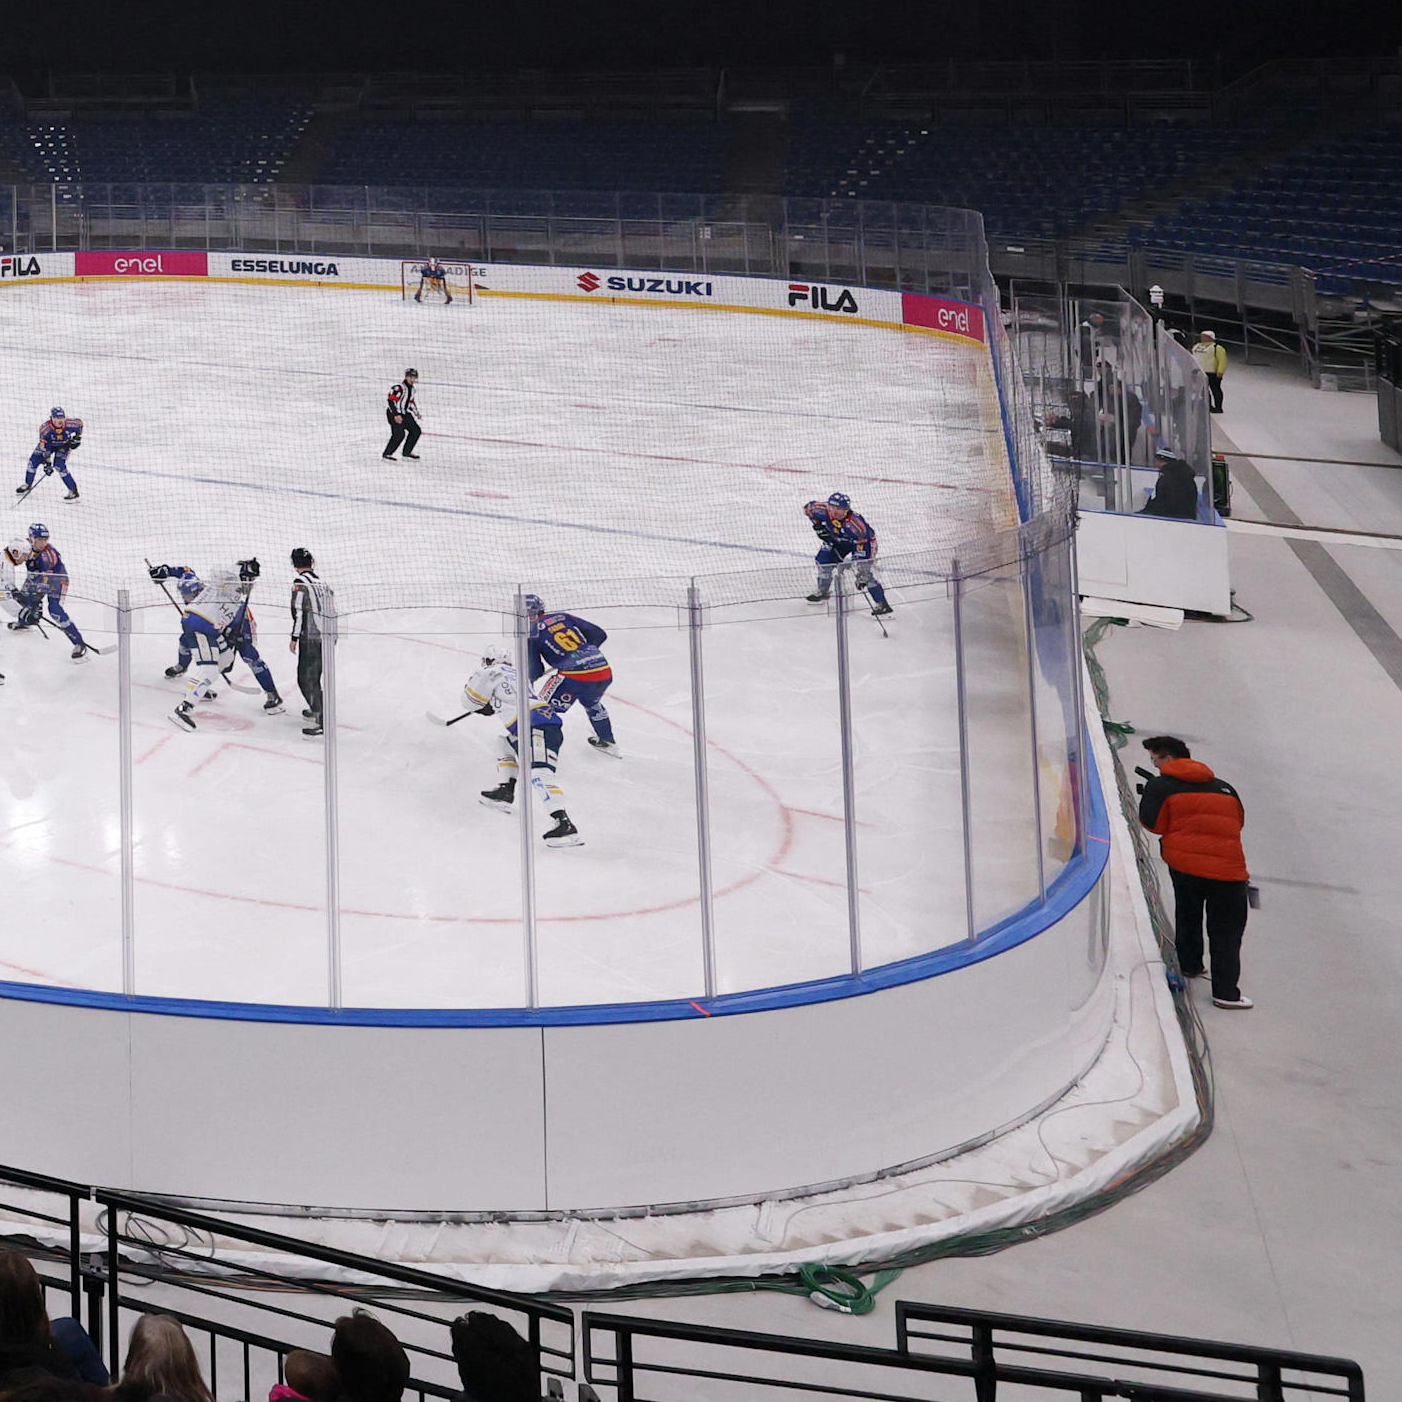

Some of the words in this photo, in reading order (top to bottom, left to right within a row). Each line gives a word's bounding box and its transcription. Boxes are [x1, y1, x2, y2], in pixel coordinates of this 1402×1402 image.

[1, 256, 40, 278] FILA
[114, 254, 163, 273] enel
[231, 259, 338, 276] ESSELUNGA
[607, 276, 712, 296] SUZUKI
[788, 284, 858, 313] FILA
[938, 307, 970, 333] enel
